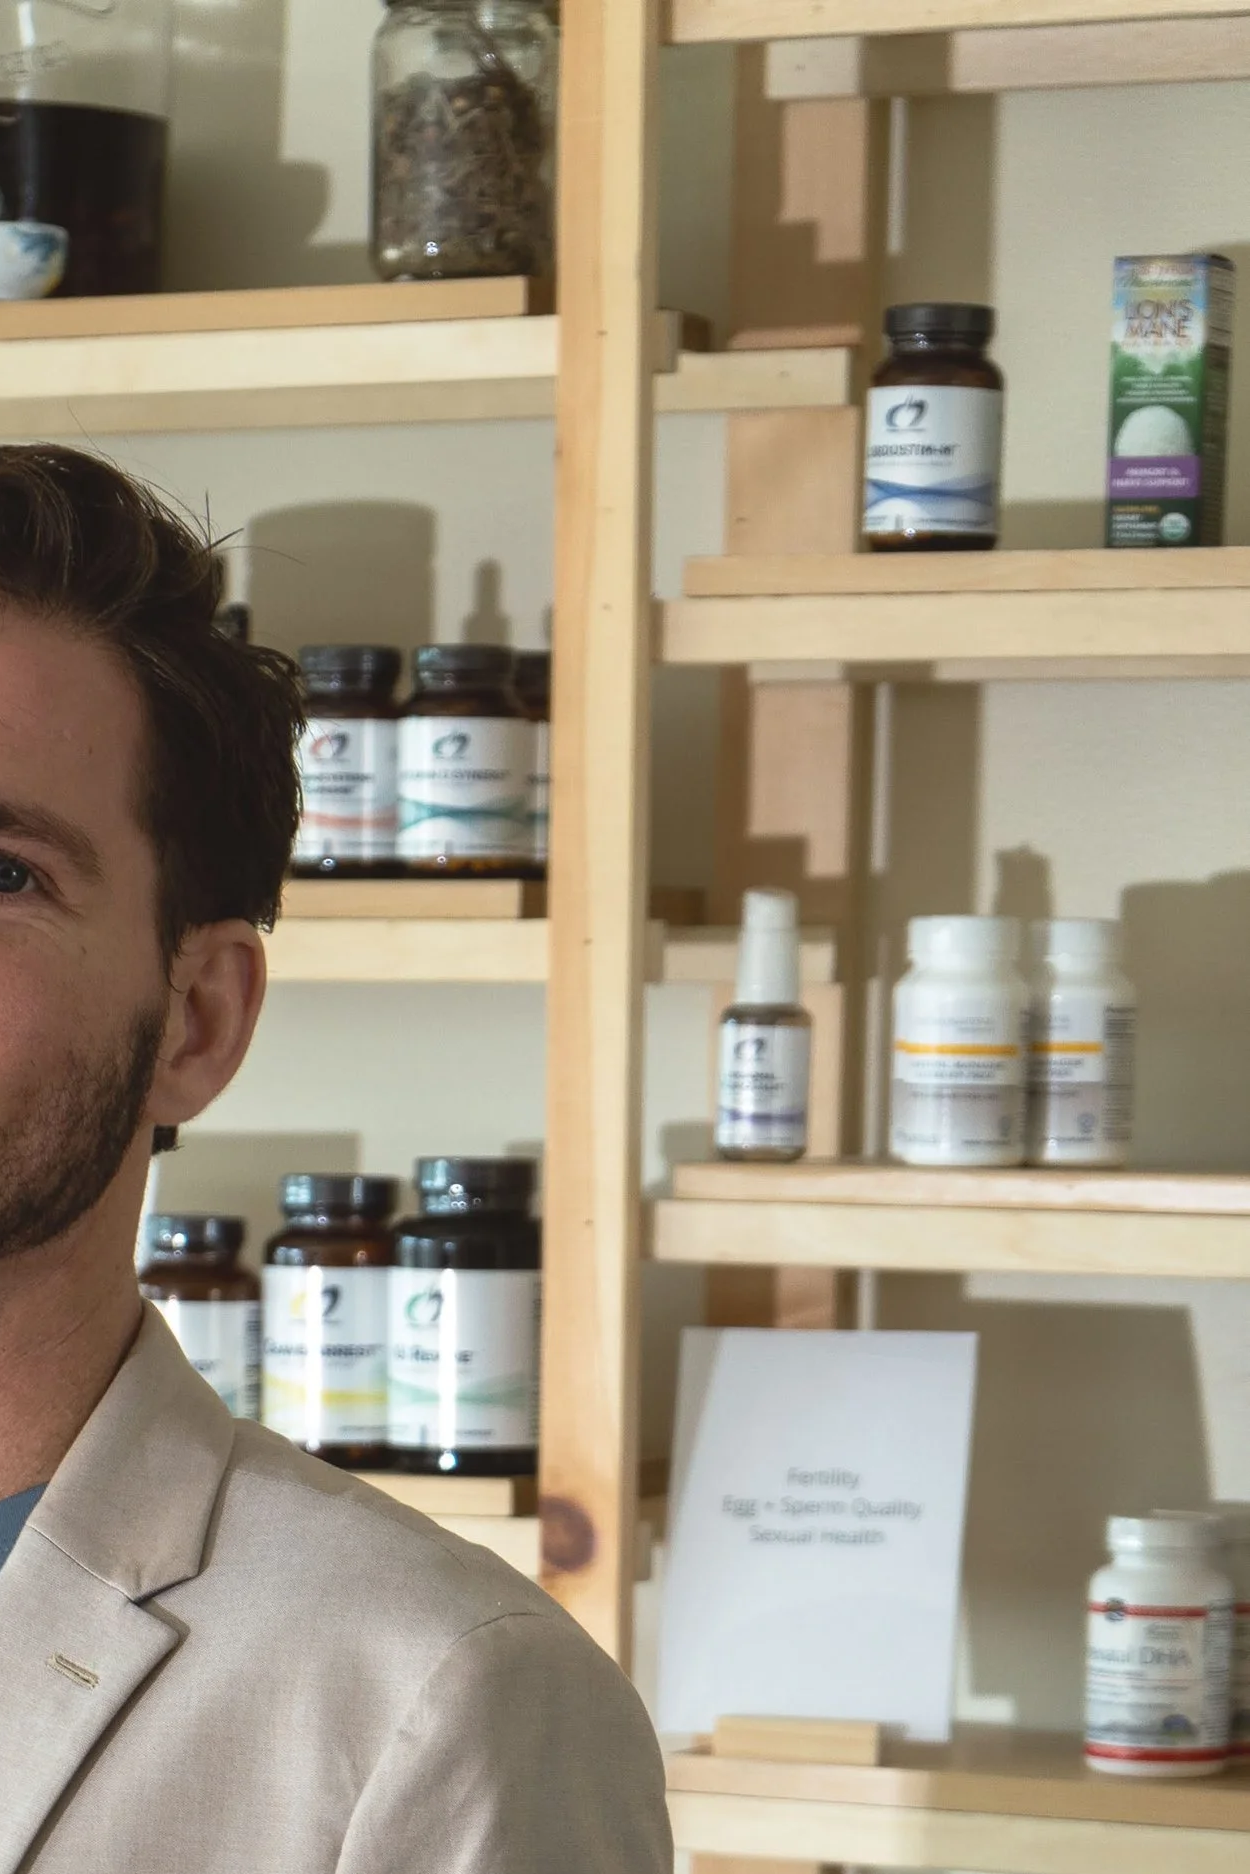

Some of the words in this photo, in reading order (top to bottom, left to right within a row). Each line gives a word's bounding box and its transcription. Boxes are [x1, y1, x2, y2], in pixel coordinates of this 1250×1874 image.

[1125, 320, 1189, 338] MANE
[787, 1467, 861, 1489] Fertility
[722, 1495, 758, 1517] Egg
[780, 1496, 847, 1516] Sperm
[851, 1497, 923, 1520] Quality
[750, 1525, 813, 1544] Sexual
[820, 1526, 886, 1545] Health
[1140, 1647, 1191, 1666] DHA
